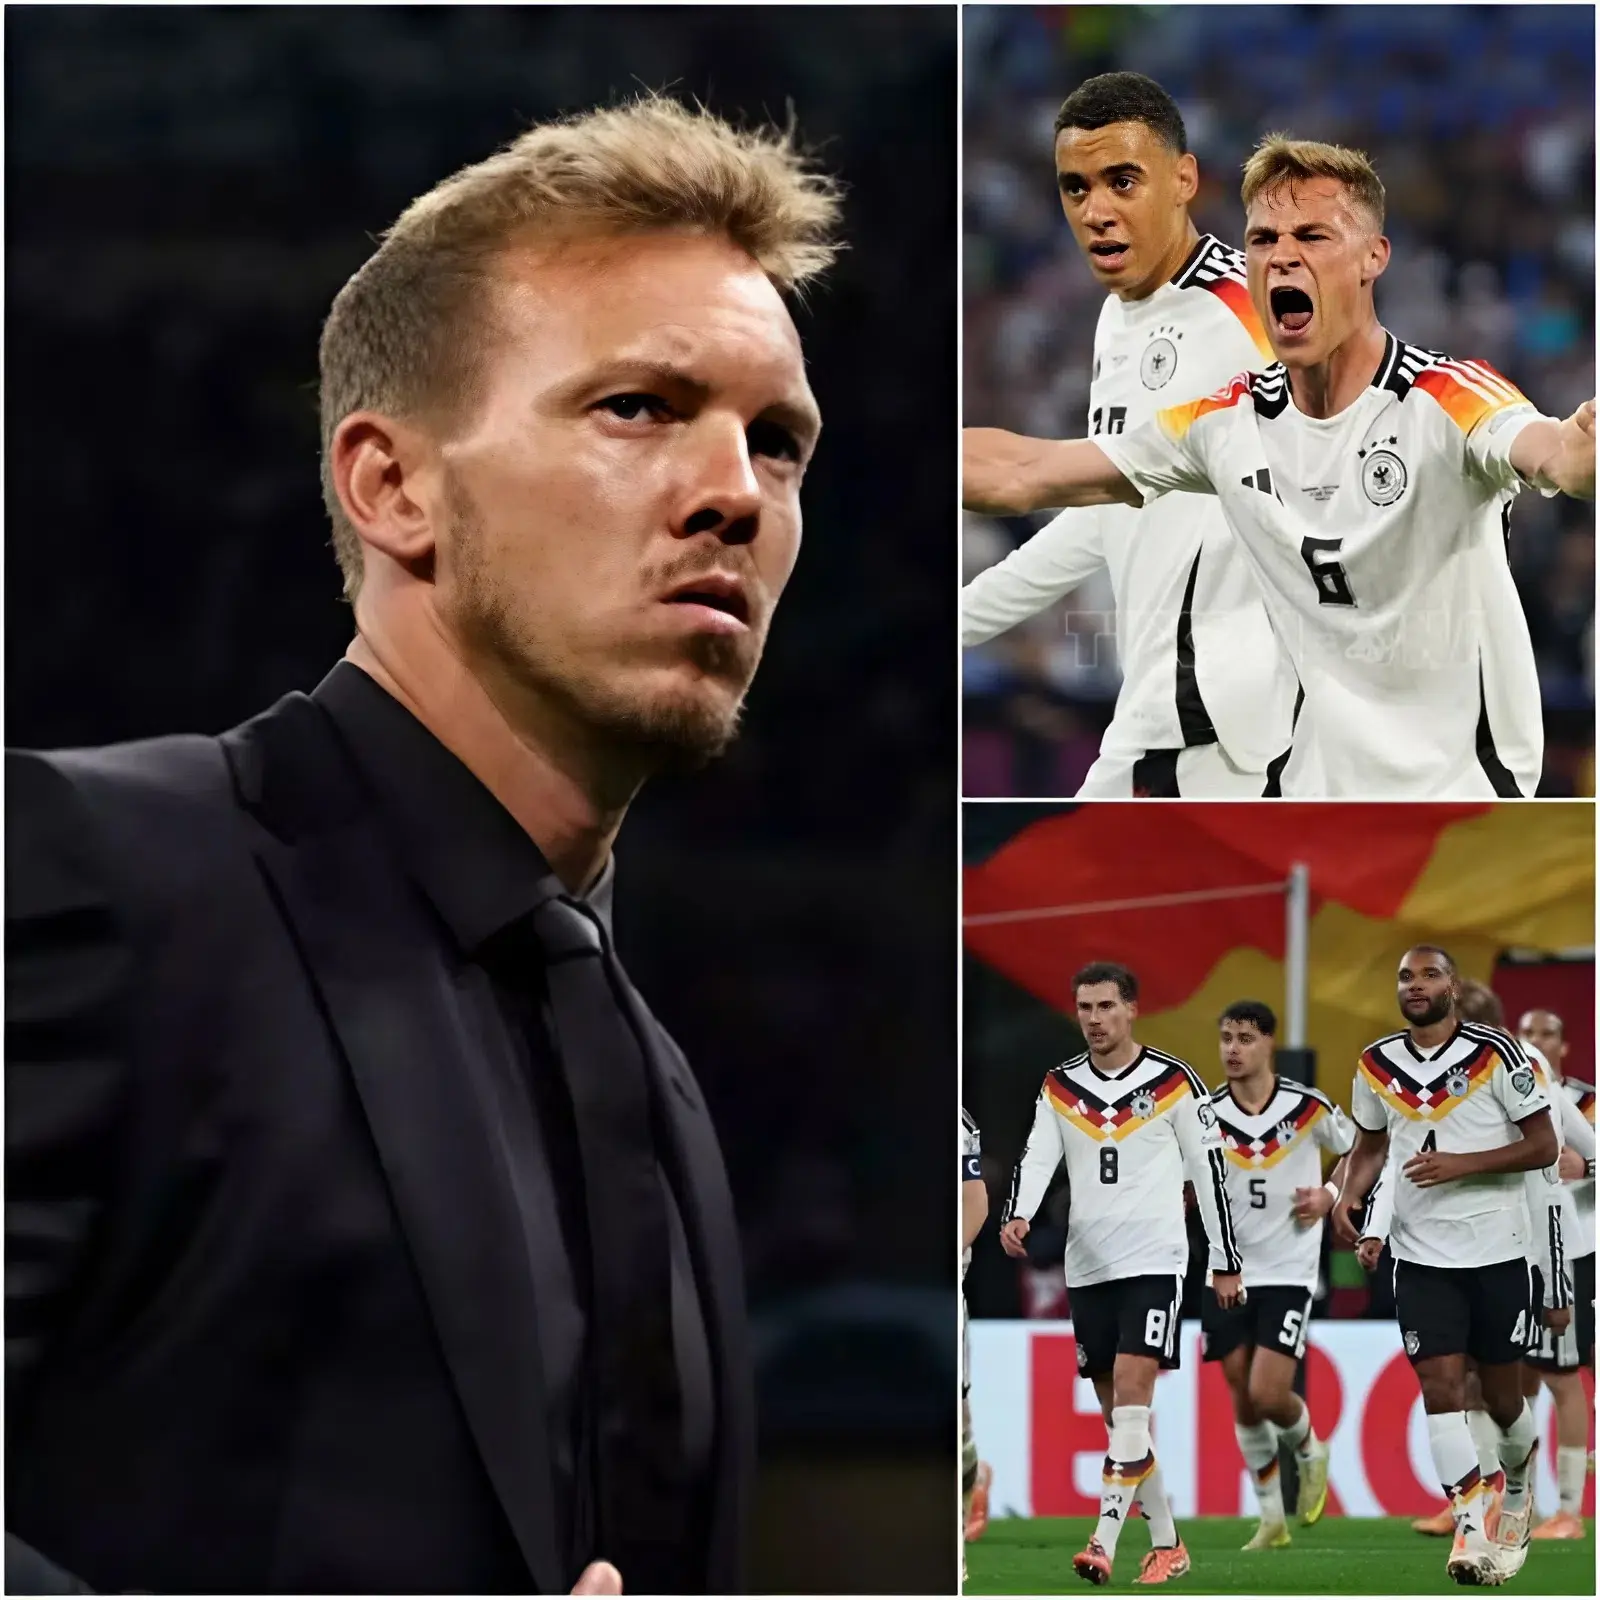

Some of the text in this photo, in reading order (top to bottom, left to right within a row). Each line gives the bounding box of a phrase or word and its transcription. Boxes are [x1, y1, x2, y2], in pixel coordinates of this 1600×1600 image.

[1300, 535, 1357, 608] 6
[967, 1158, 982, 1175] C
[1100, 1146, 1119, 1184] 8
[1249, 1179, 1267, 1209] 5
[1144, 1308, 1167, 1348] 8
[1278, 1309, 1303, 1347] 5
[1509, 1309, 1526, 1345] 4
